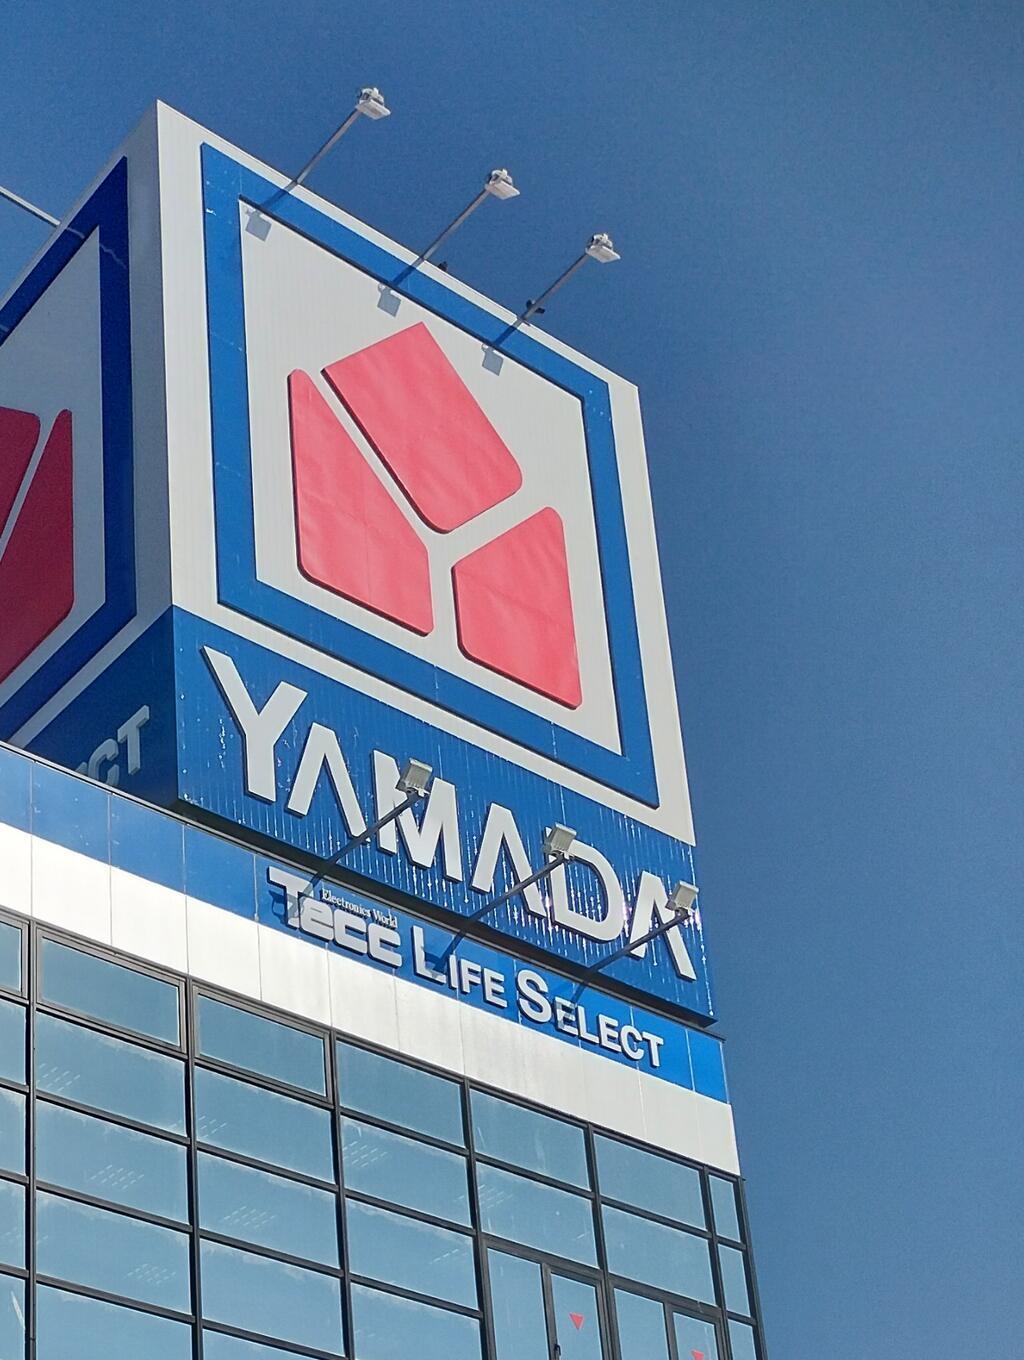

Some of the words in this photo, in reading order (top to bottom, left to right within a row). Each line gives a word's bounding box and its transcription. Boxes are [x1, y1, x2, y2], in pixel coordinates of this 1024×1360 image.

[202, 646, 696, 981] YAMADA
[322, 887, 371, 918] Electronics
[373, 908, 398, 929] World
